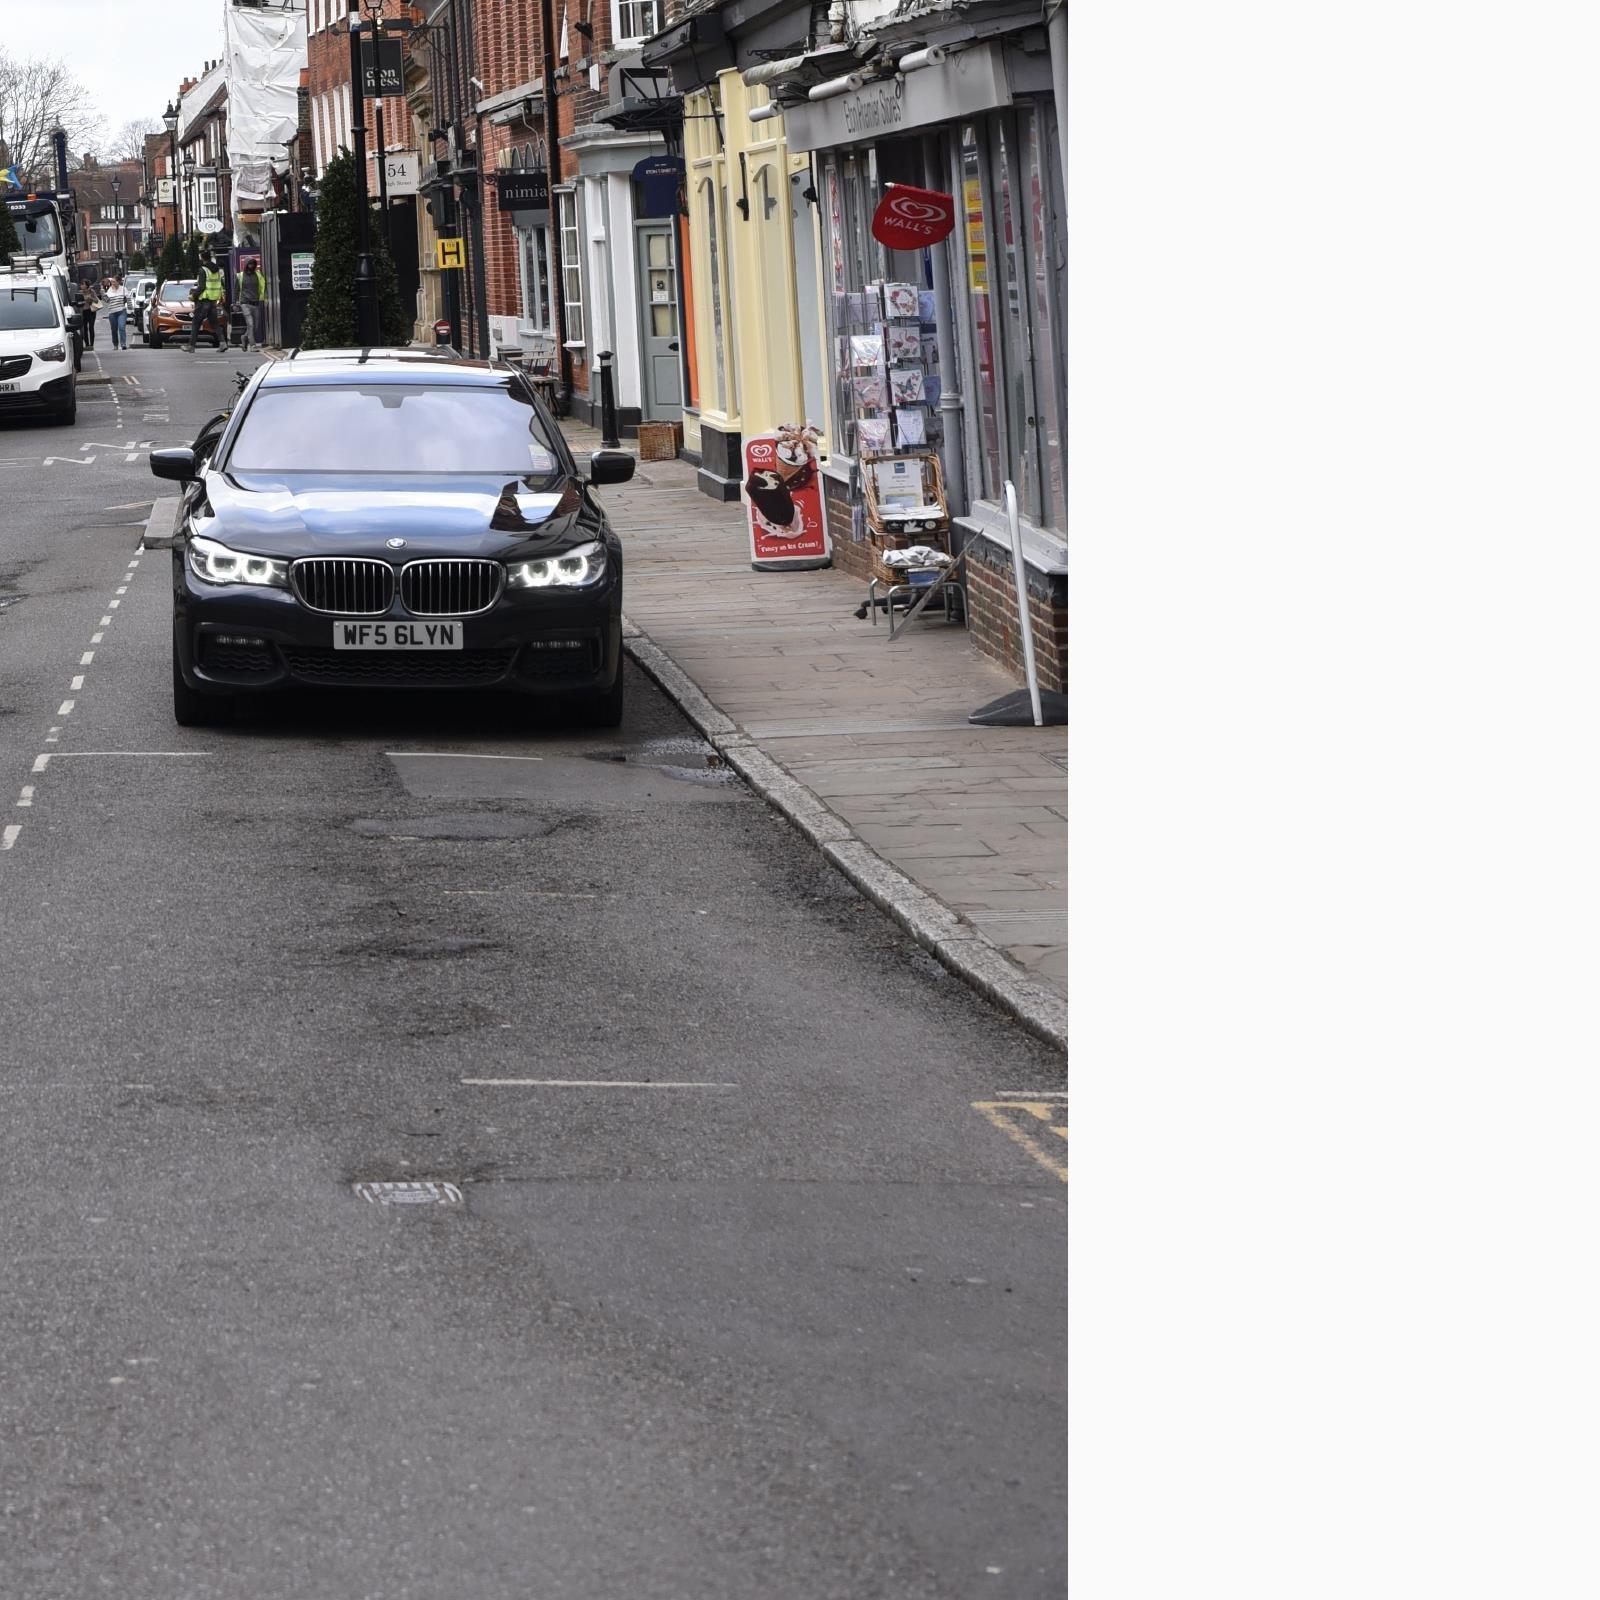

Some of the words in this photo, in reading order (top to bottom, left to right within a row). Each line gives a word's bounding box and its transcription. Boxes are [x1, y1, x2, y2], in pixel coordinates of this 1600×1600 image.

[366, 69, 396, 79] eon
[387, 163, 407, 178] 54
[505, 183, 548, 199] nimia
[884, 215, 934, 236] WALL'S
[441, 241, 461, 265] H
